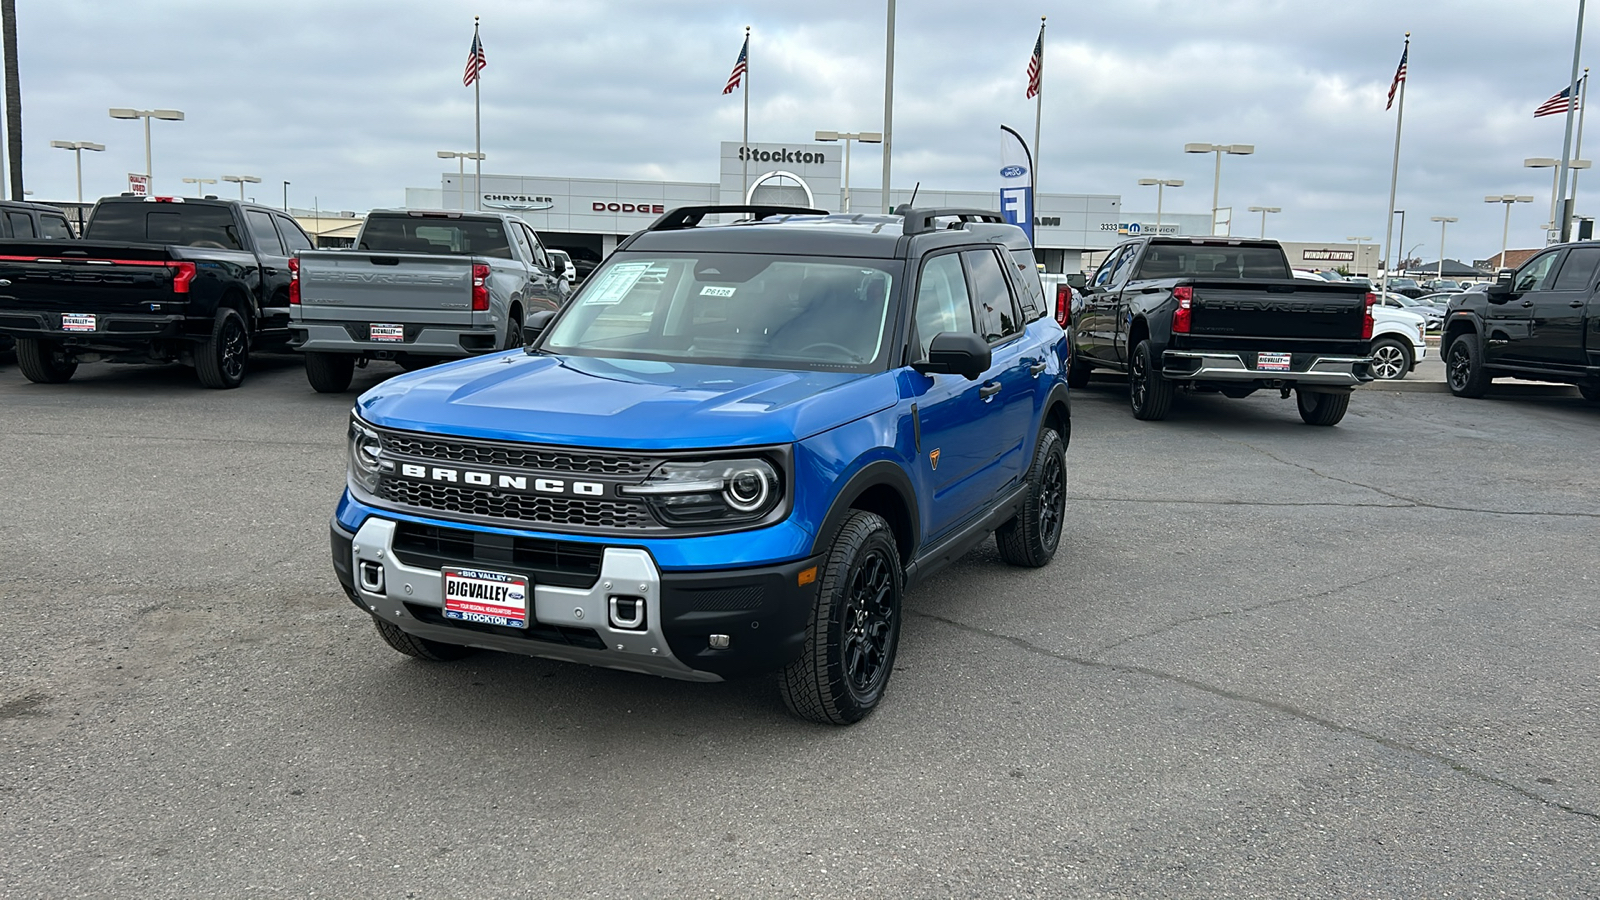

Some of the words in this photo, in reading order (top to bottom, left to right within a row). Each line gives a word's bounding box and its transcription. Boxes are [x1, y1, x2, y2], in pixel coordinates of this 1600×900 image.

[738, 146, 825, 164] Stockton
[130, 176, 147, 184] QUALITY
[132, 184, 145, 192] USED
[484, 194, 553, 203] CHRYSLER
[592, 202, 664, 214] DODGE
[1100, 223, 1118, 231] 3333
[1304, 251, 1330, 259] WINDOW
[1330, 252, 1353, 260] TINTING
[308, 270, 460, 286] CHEVROLET
[705, 288, 730, 296] P6128
[1204, 300, 1354, 313] CHEVROLET
[402, 463, 603, 496] BRONCO
[462, 570, 477, 578] BIG
[478, 572, 507, 582] VALLEY
[447, 580, 509, 602] BIGVALLEY
[485, 606, 512, 615] HEADQUARTERS
[462, 612, 508, 625] STOCKTON
